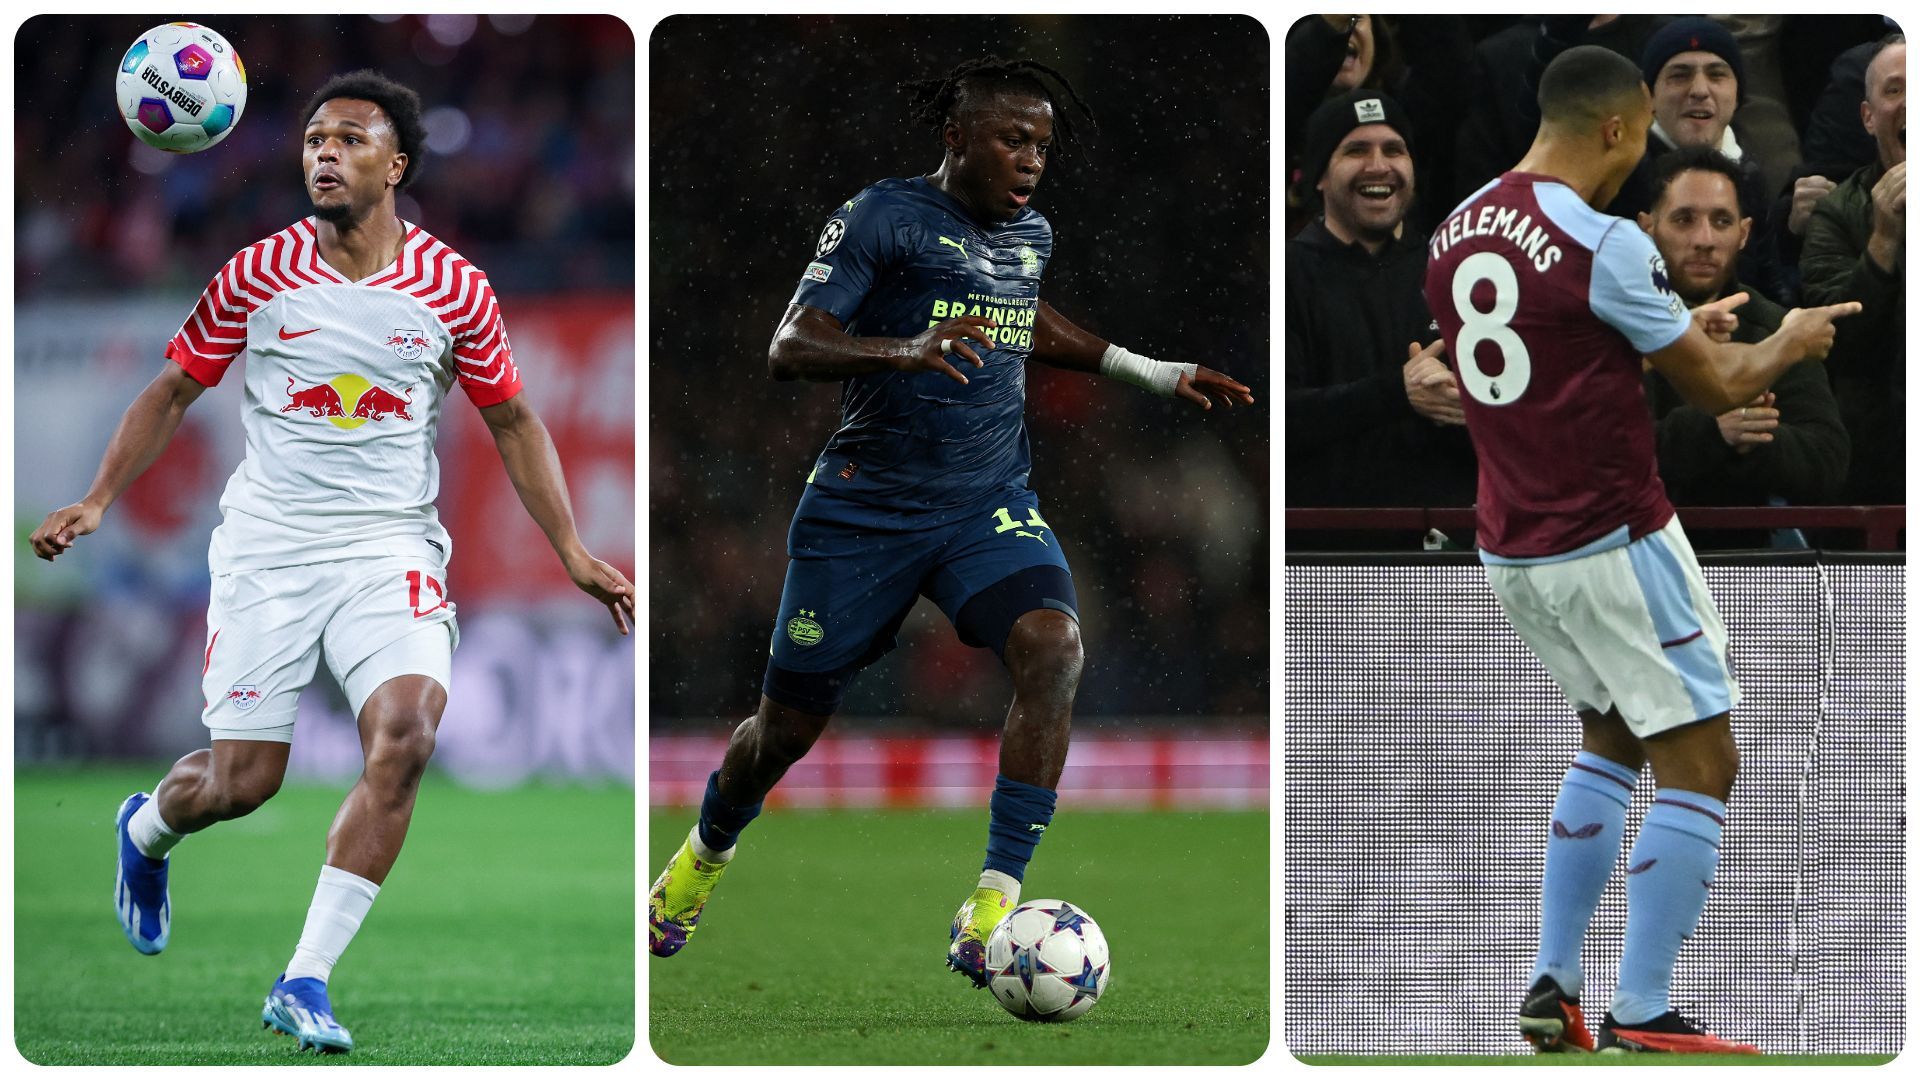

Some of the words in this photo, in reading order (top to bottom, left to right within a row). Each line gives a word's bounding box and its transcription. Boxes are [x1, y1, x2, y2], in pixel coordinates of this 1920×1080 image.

[141, 66, 203, 118] DERBYSTAR
[1431, 206, 1562, 272] TIELEMANS
[932, 299, 1036, 327] BRAINPOR
[1452, 252, 1531, 405] 8
[991, 507, 1050, 533] 11
